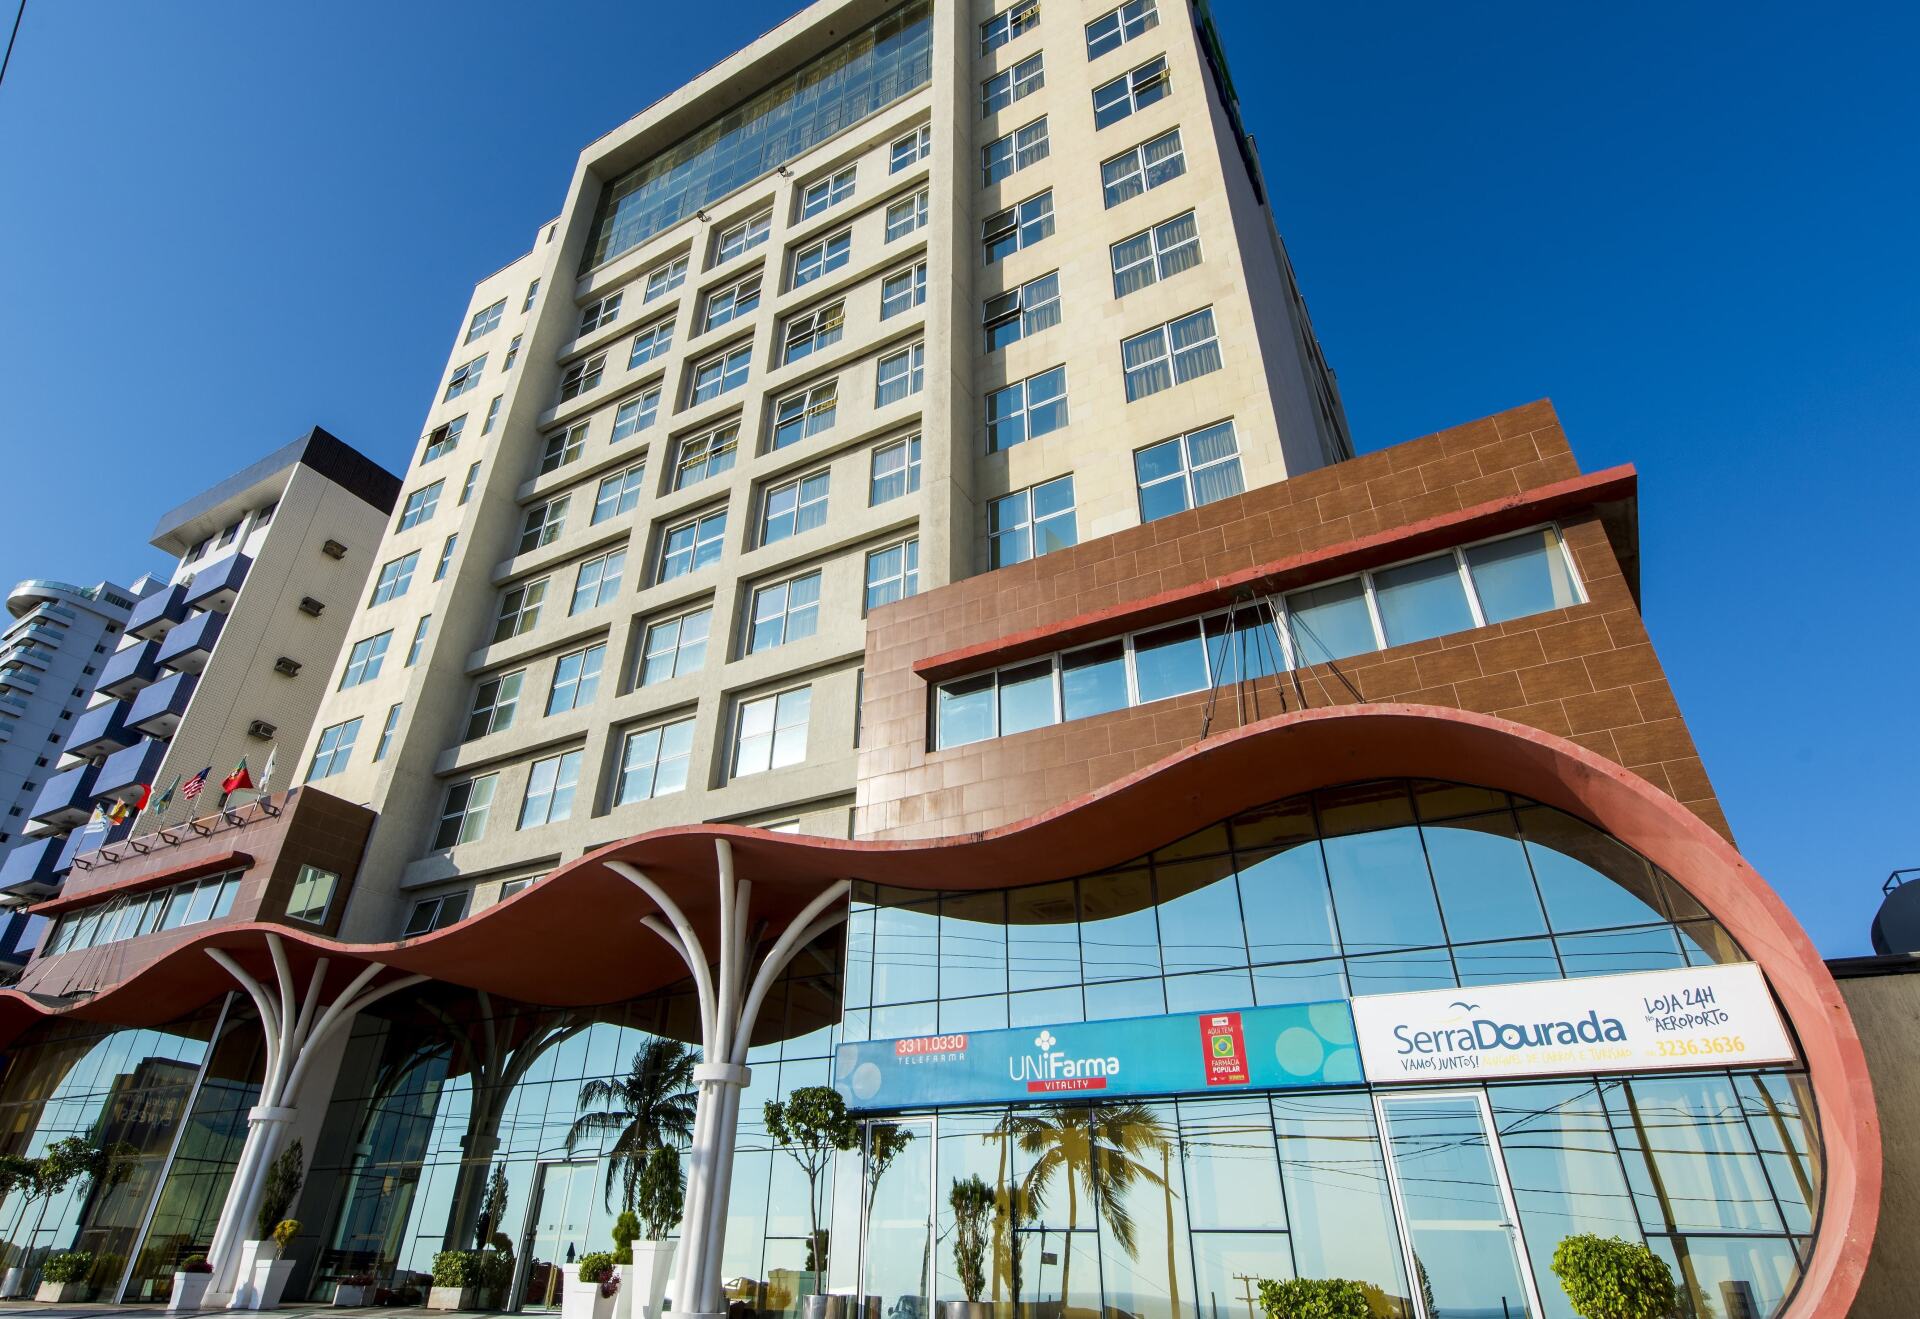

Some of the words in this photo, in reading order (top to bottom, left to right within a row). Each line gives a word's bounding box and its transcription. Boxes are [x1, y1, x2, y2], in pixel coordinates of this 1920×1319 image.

[1643, 994, 1683, 1014] LOJA
[1683, 986, 1715, 1009] 24H
[1655, 1008, 1729, 1032] AEROPORTO
[898, 1035, 964, 1053] 3311.0330
[1655, 1036, 1745, 1056] 3236.3636
[898, 1053, 965, 1065] TELEFARMA
[1044, 1080, 1089, 1090] VITALITY
